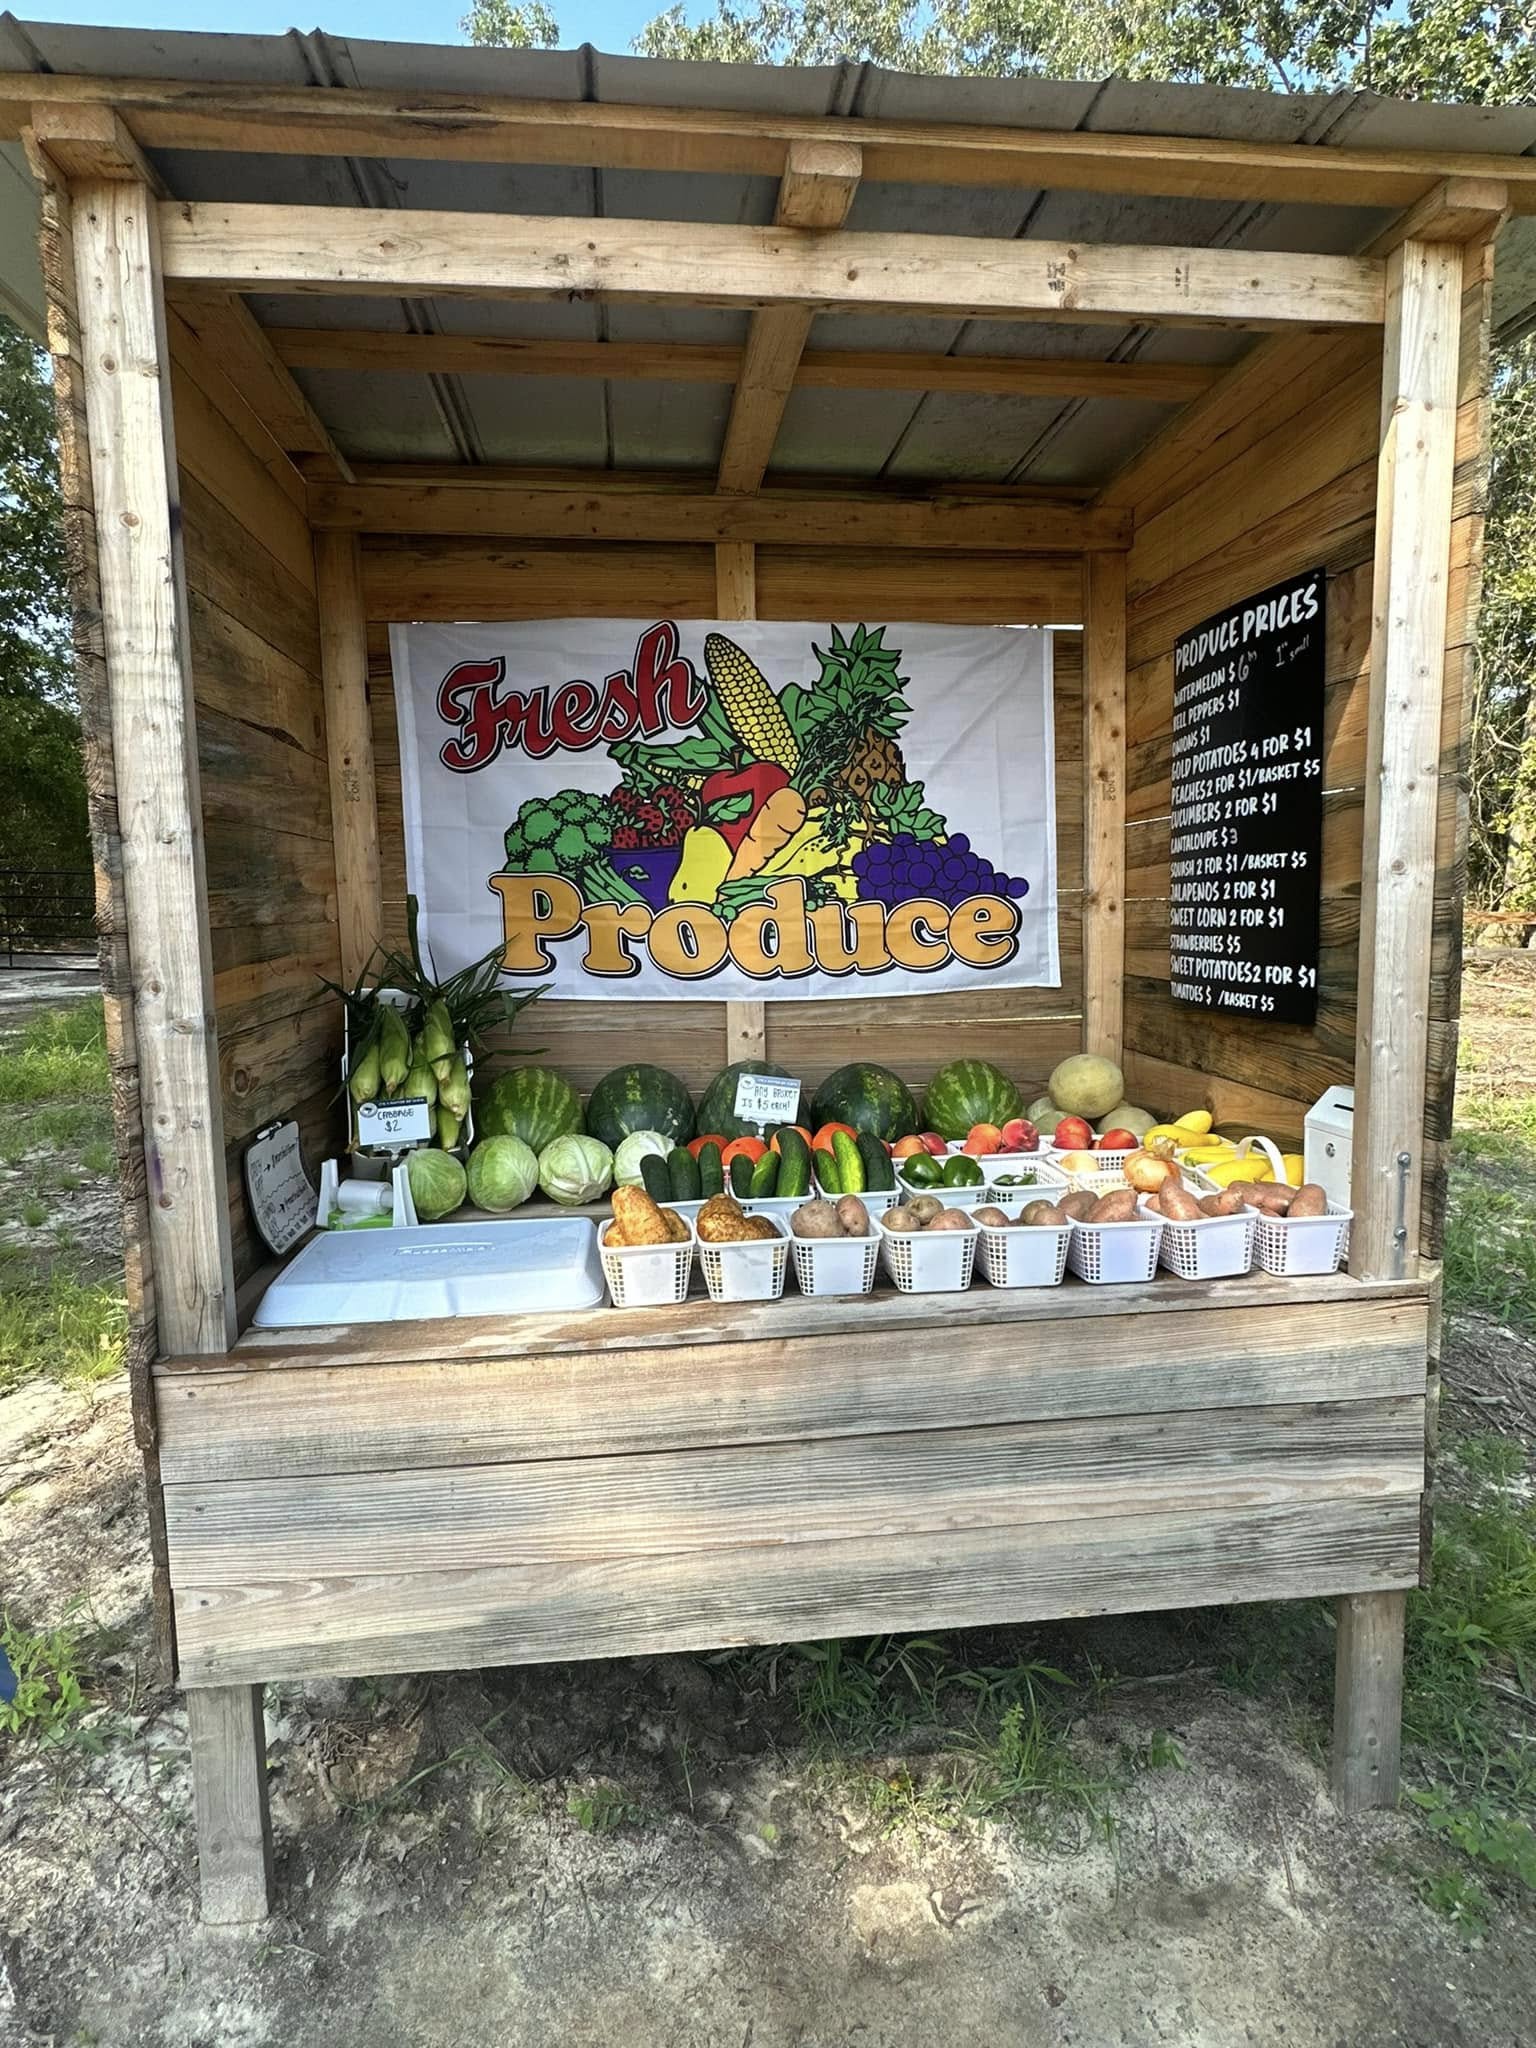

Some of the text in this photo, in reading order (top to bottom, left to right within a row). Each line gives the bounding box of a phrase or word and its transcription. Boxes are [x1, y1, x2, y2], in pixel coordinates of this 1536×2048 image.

[1175, 583, 1318, 677] PRODUCE PRICES
[438, 620, 708, 774] Fresh
[1173, 666, 1226, 708] WATERMELON
[1173, 687, 1240, 732] BELL PEPPERS $1
[1171, 725, 1211, 758] ONIONS $1
[1192, 740, 1248, 776] POTATOES
[1250, 742, 1260, 761] 4
[1262, 733, 1289, 758] FOR
[1293, 726, 1312, 751] $1
[1170, 779, 1206, 806] PEACHES
[1215, 773, 1235, 795] FOR
[1303, 758, 1321, 778] $5
[1170, 792, 1277, 829] CUCUMBERS 2 FOR $1
[1170, 826, 1238, 854] CANTALOUPE $3
[1170, 859, 1195, 878] SQUASH
[1196, 858, 1203, 875] 2
[1204, 856, 1223, 875] FOR
[1225, 853, 1238, 874] $1
[1291, 850, 1307, 870] $5
[1170, 878, 1276, 902] JALAPENOS 2 FOR $1
[488, 871, 1022, 981] Produce
[1170, 906, 1284, 929] SWEET CORN 2 FOR $1
[1170, 933, 1241, 955] STRAWBERRIES $5
[1170, 955, 1195, 977] SWEET
[1195, 957, 1252, 983] POTATOES
[1264, 965, 1293, 985] FOR
[1298, 964, 1316, 988] $1
[1170, 981, 1204, 1003] TOMATOES
[1205, 984, 1212, 1006] $
[1260, 994, 1275, 1012] $5
[377, 1107, 415, 1121] CABBAGE
[384, 1119, 403, 1133] $2
